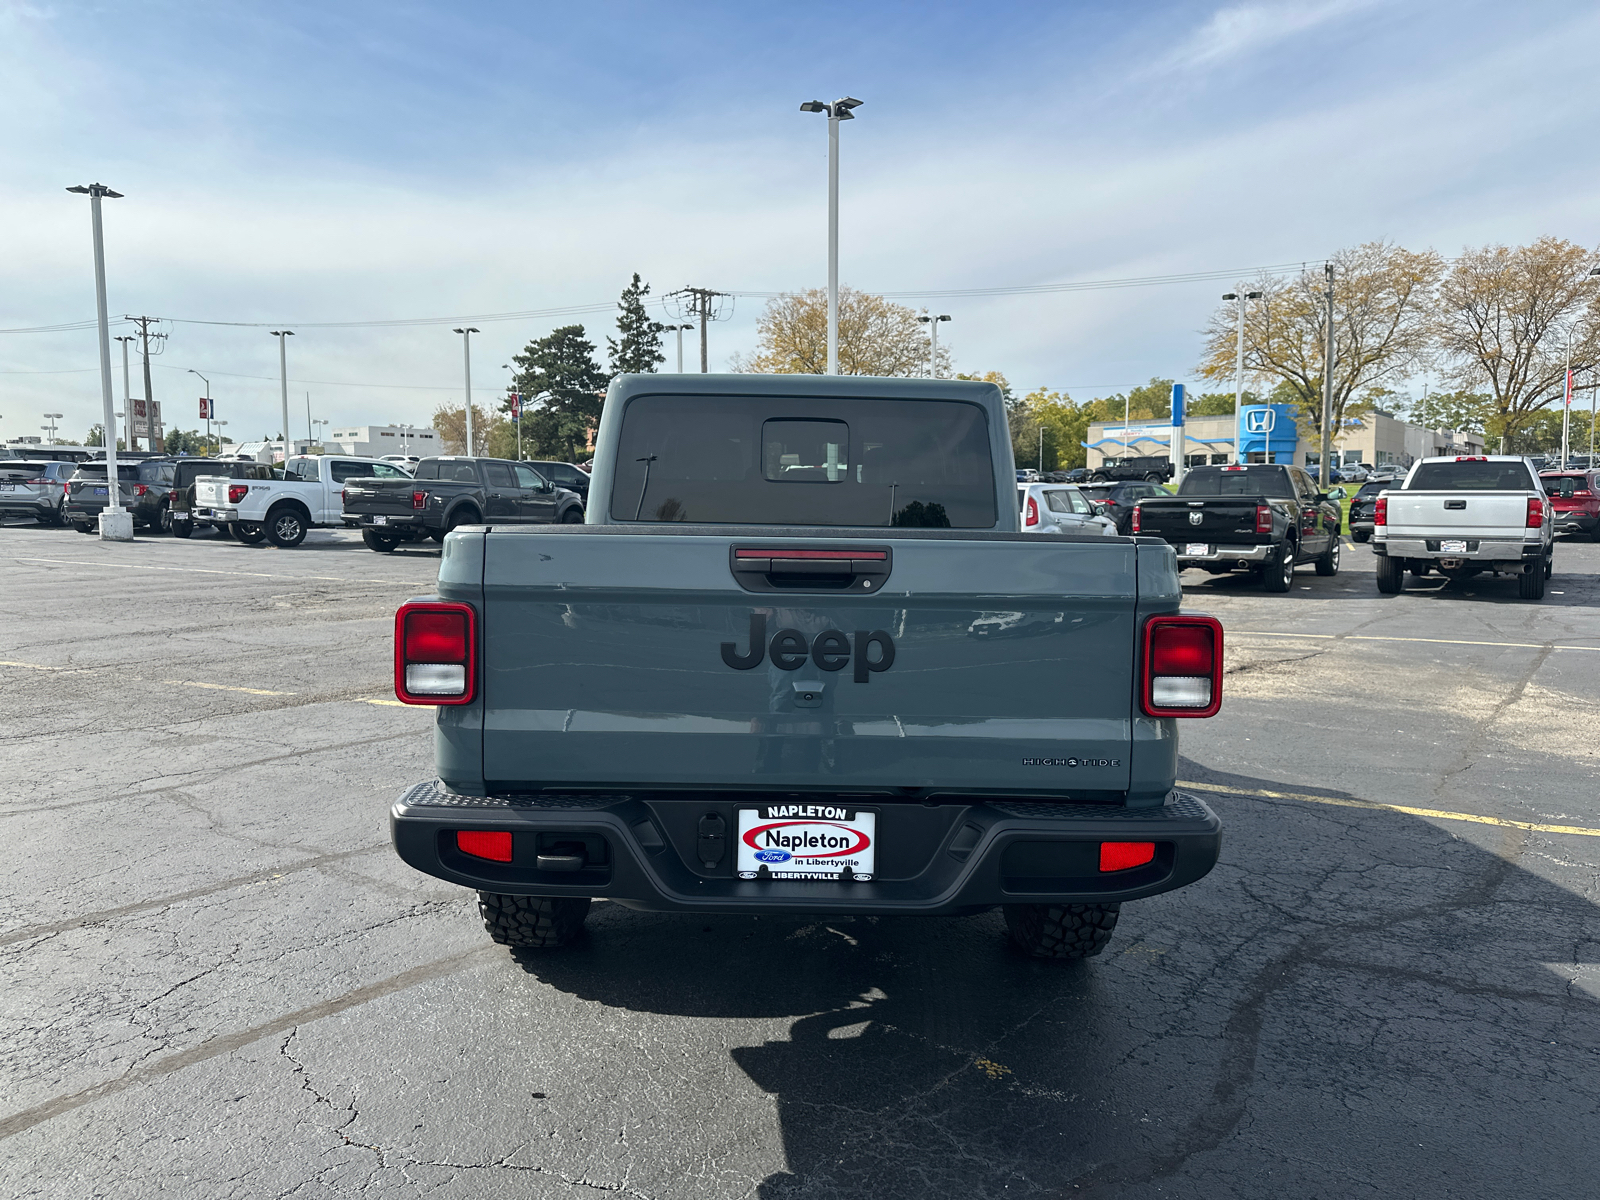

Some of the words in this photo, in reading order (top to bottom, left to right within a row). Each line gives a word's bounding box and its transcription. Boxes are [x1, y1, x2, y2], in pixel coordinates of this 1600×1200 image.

[720, 613, 896, 683] Jeep
[1022, 758, 1066, 766] HIGH
[1080, 759, 1120, 767] TIDE
[767, 805, 847, 820] NAPLETON
[765, 830, 850, 851] Napleton
[761, 851, 785, 861] Ford
[806, 858, 860, 867] Libertyville
[771, 872, 840, 880] LIBERTYVILLE
